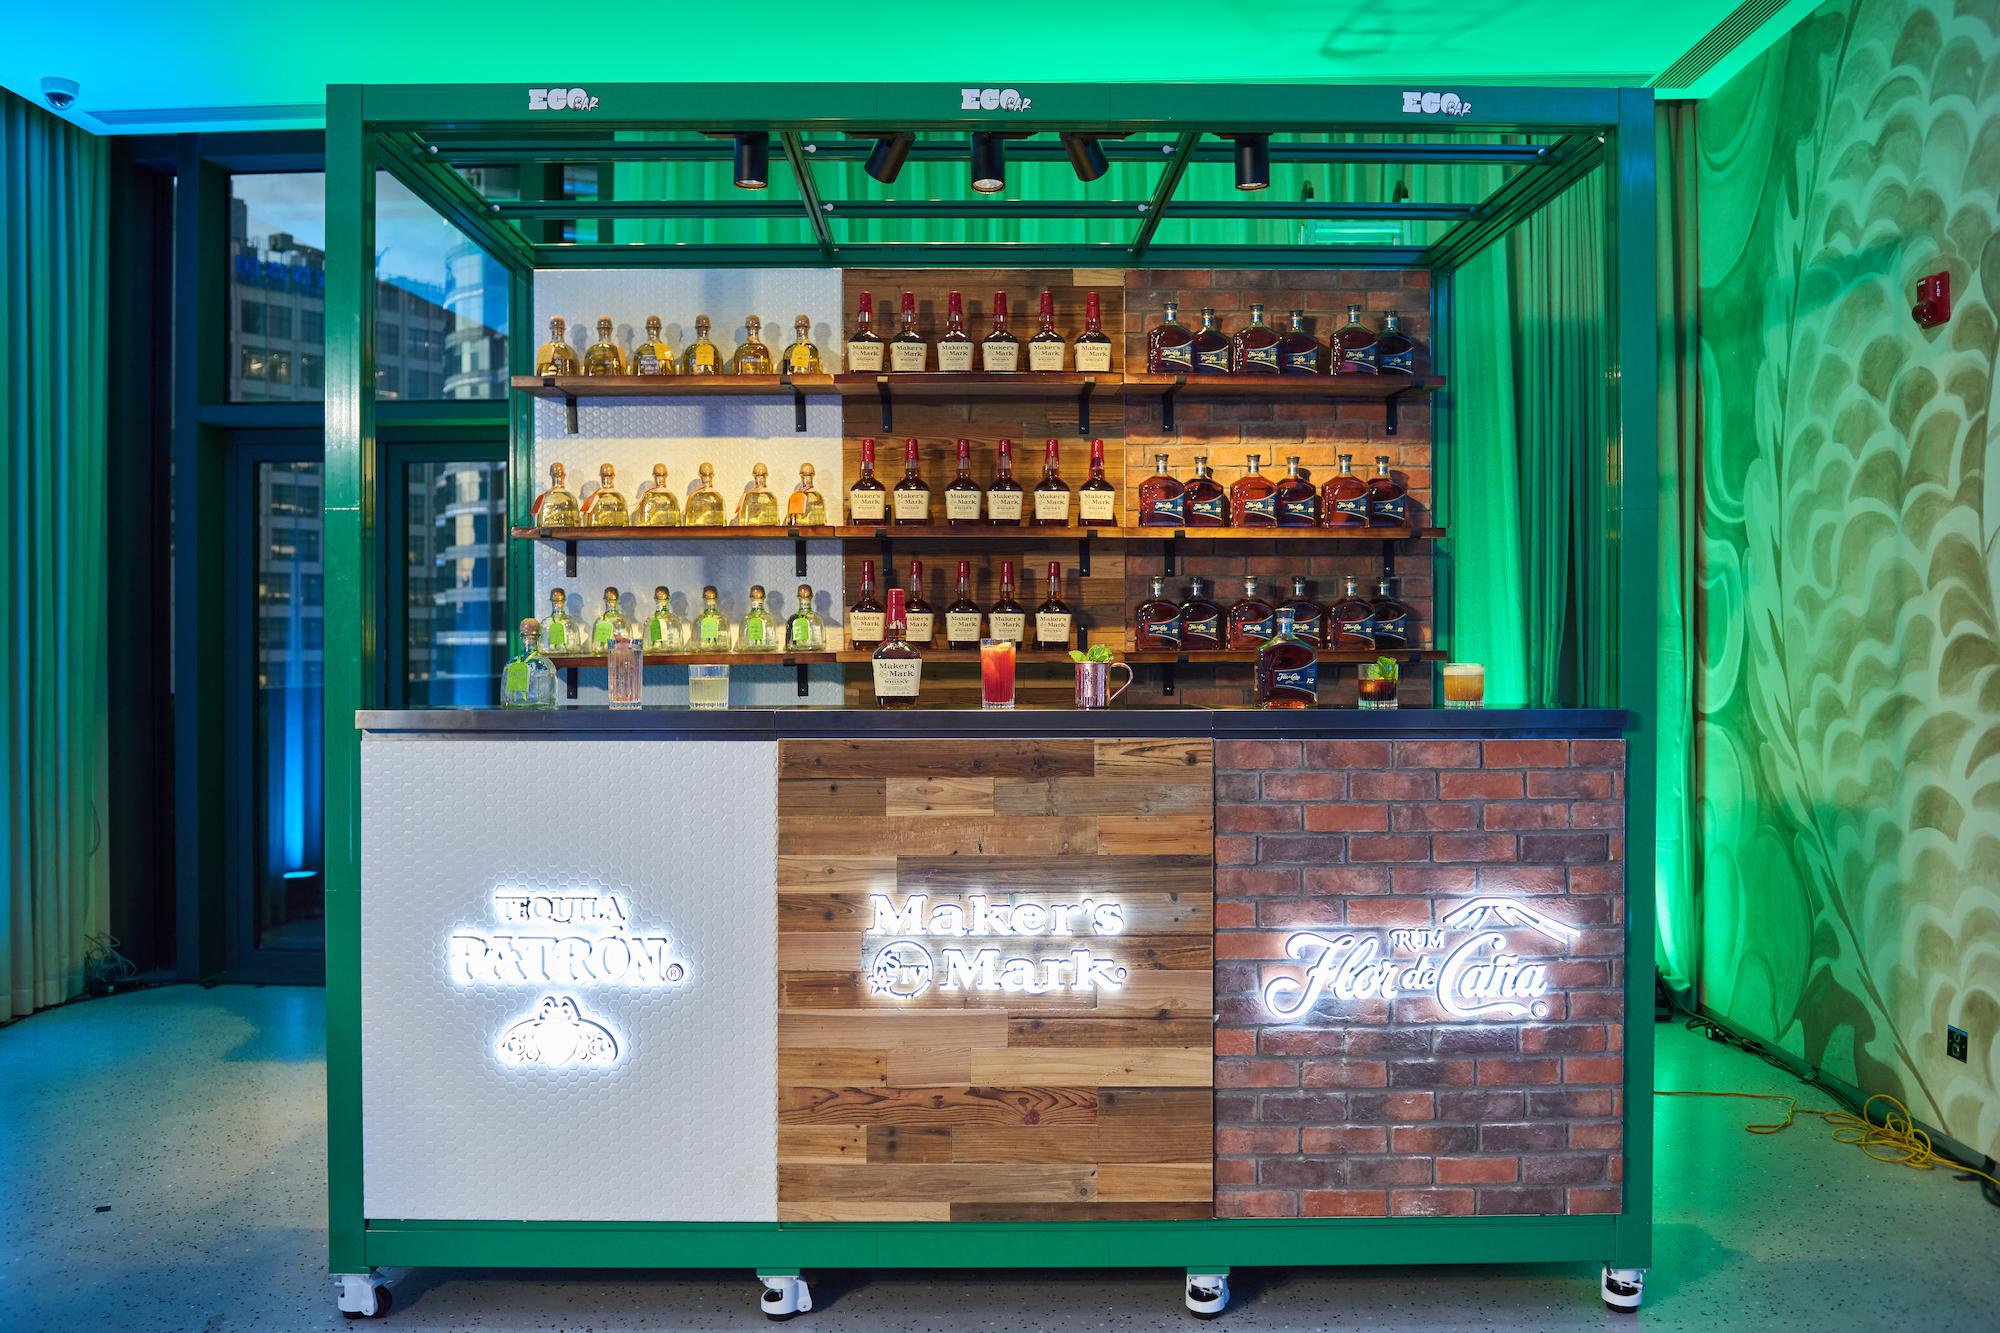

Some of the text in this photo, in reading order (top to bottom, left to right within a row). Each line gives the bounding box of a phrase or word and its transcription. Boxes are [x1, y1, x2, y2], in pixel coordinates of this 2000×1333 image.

[528, 88, 588, 110] ECO
[961, 88, 1020, 110] ECO
[1402, 91, 1460, 114] ECO
[866, 894, 1125, 938] Maker's
[1388, 928, 1446, 952] RUM
[940, 948, 1124, 994] Mark
[1264, 930, 1548, 1018] Flor de Caña
